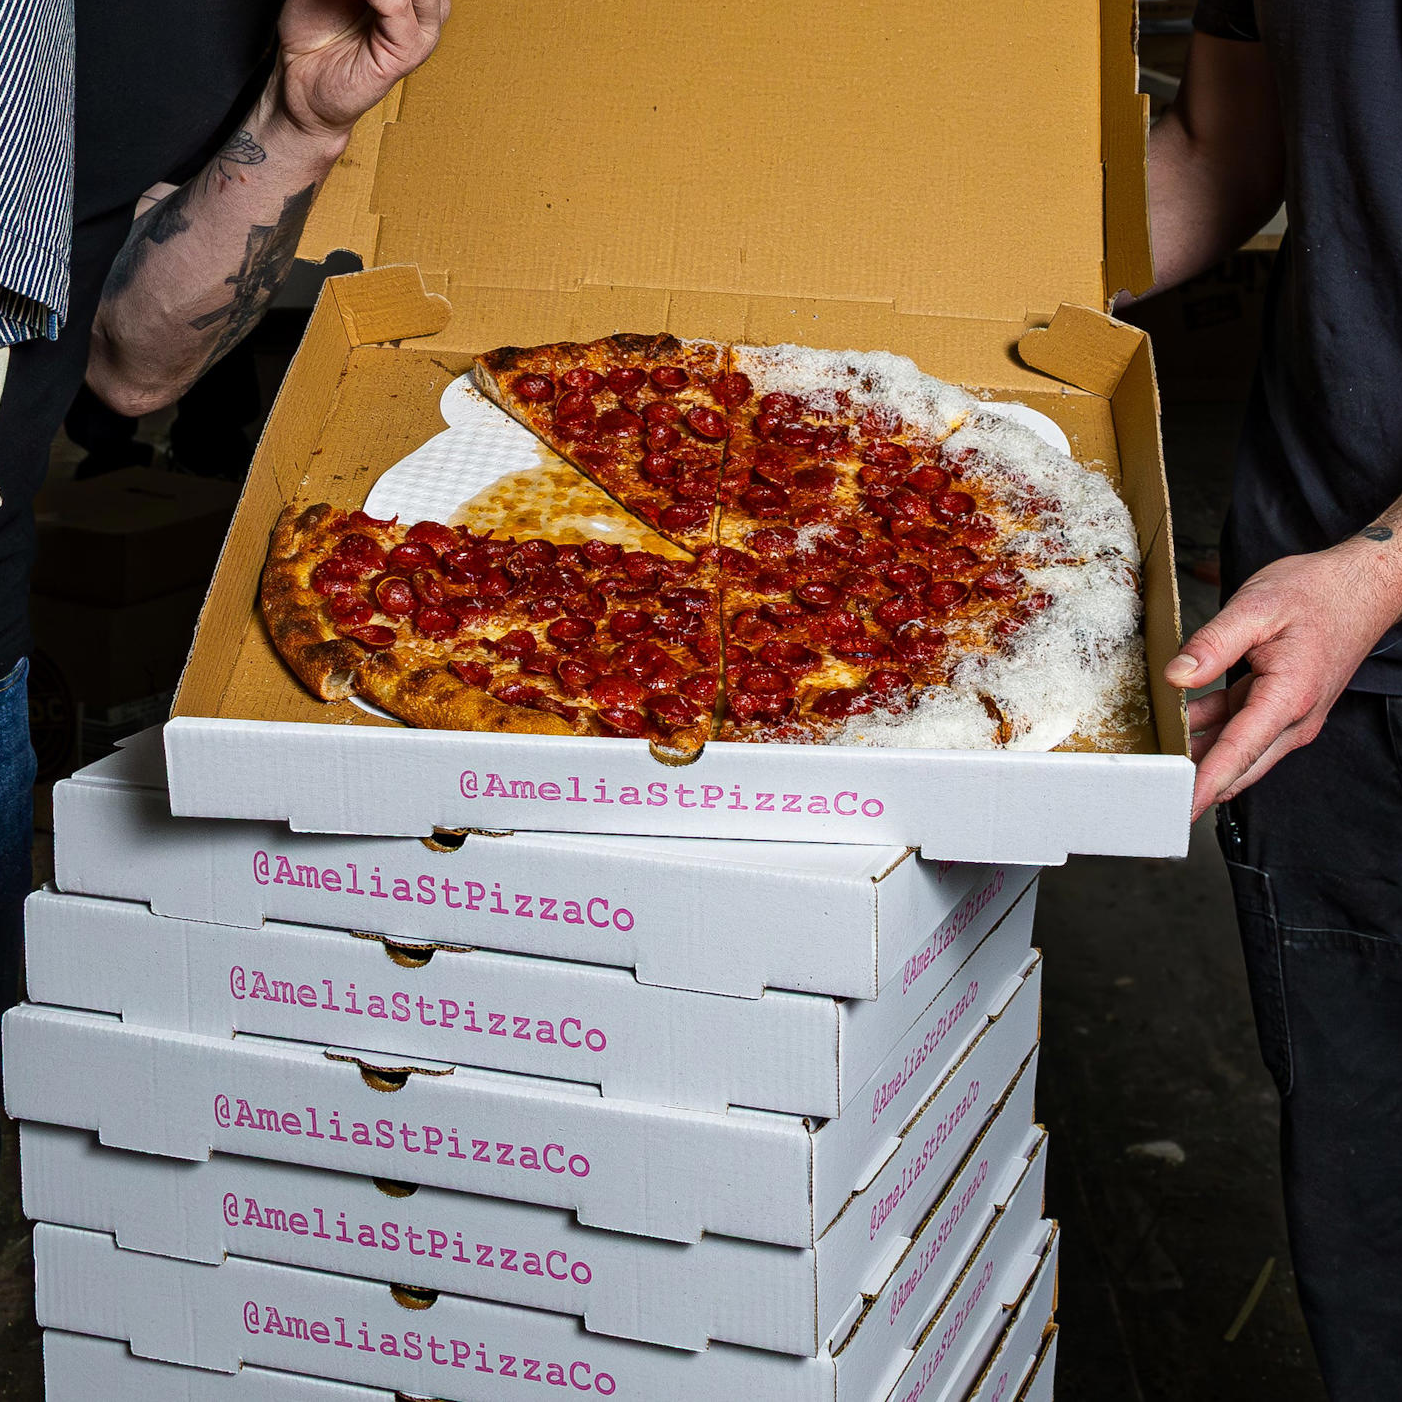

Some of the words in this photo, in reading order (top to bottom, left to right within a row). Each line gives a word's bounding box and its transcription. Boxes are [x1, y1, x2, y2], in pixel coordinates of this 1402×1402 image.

[459, 769, 885, 817] @AmeliaStPizzaCo
[252, 849, 636, 933] @AmeliaStPizzaCo
[229, 965, 607, 1053] @AmeliaStPizzaCo
[213, 1093, 591, 1178] @AmeliaStPizzaCo
[222, 1192, 593, 1285] @AmeliaStPizzaCo
[242, 1300, 617, 1396] @AmeliaStPizzaCo
